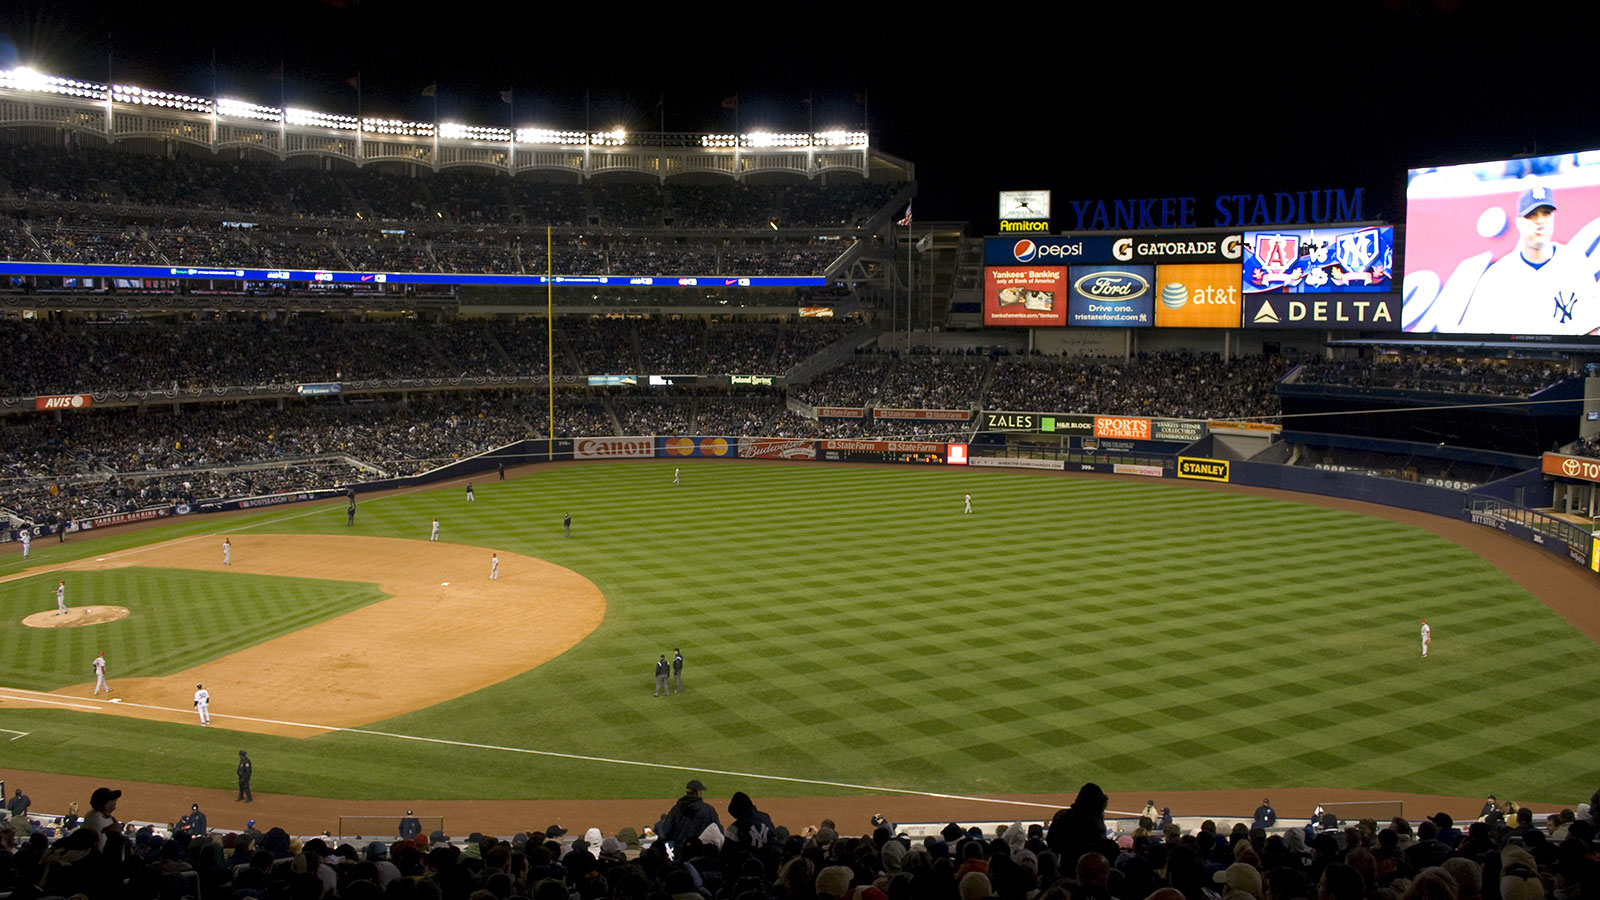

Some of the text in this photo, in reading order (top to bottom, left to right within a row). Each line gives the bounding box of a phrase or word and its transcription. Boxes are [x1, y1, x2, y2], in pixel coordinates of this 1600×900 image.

[1070, 188, 1364, 230] YANKEE STADIUM
[1000, 220, 1048, 231] Armitron
[1038, 243, 1082, 258] pepsi
[1137, 242, 1216, 255] GATORADE
[1028, 270, 1060, 279] Banking
[1091, 278, 1132, 294] Ford
[1193, 285, 1236, 304] at&t
[1288, 302, 1392, 322] DELTA
[752, 376, 772, 386] Spring
[45, 398, 72, 408] AVIS
[988, 415, 1032, 428] ZALES
[1098, 418, 1148, 431] SPORTS
[578, 440, 651, 456] Canon
[745, 440, 806, 458] Budweiser
[1184, 462, 1224, 475] STANLEY
